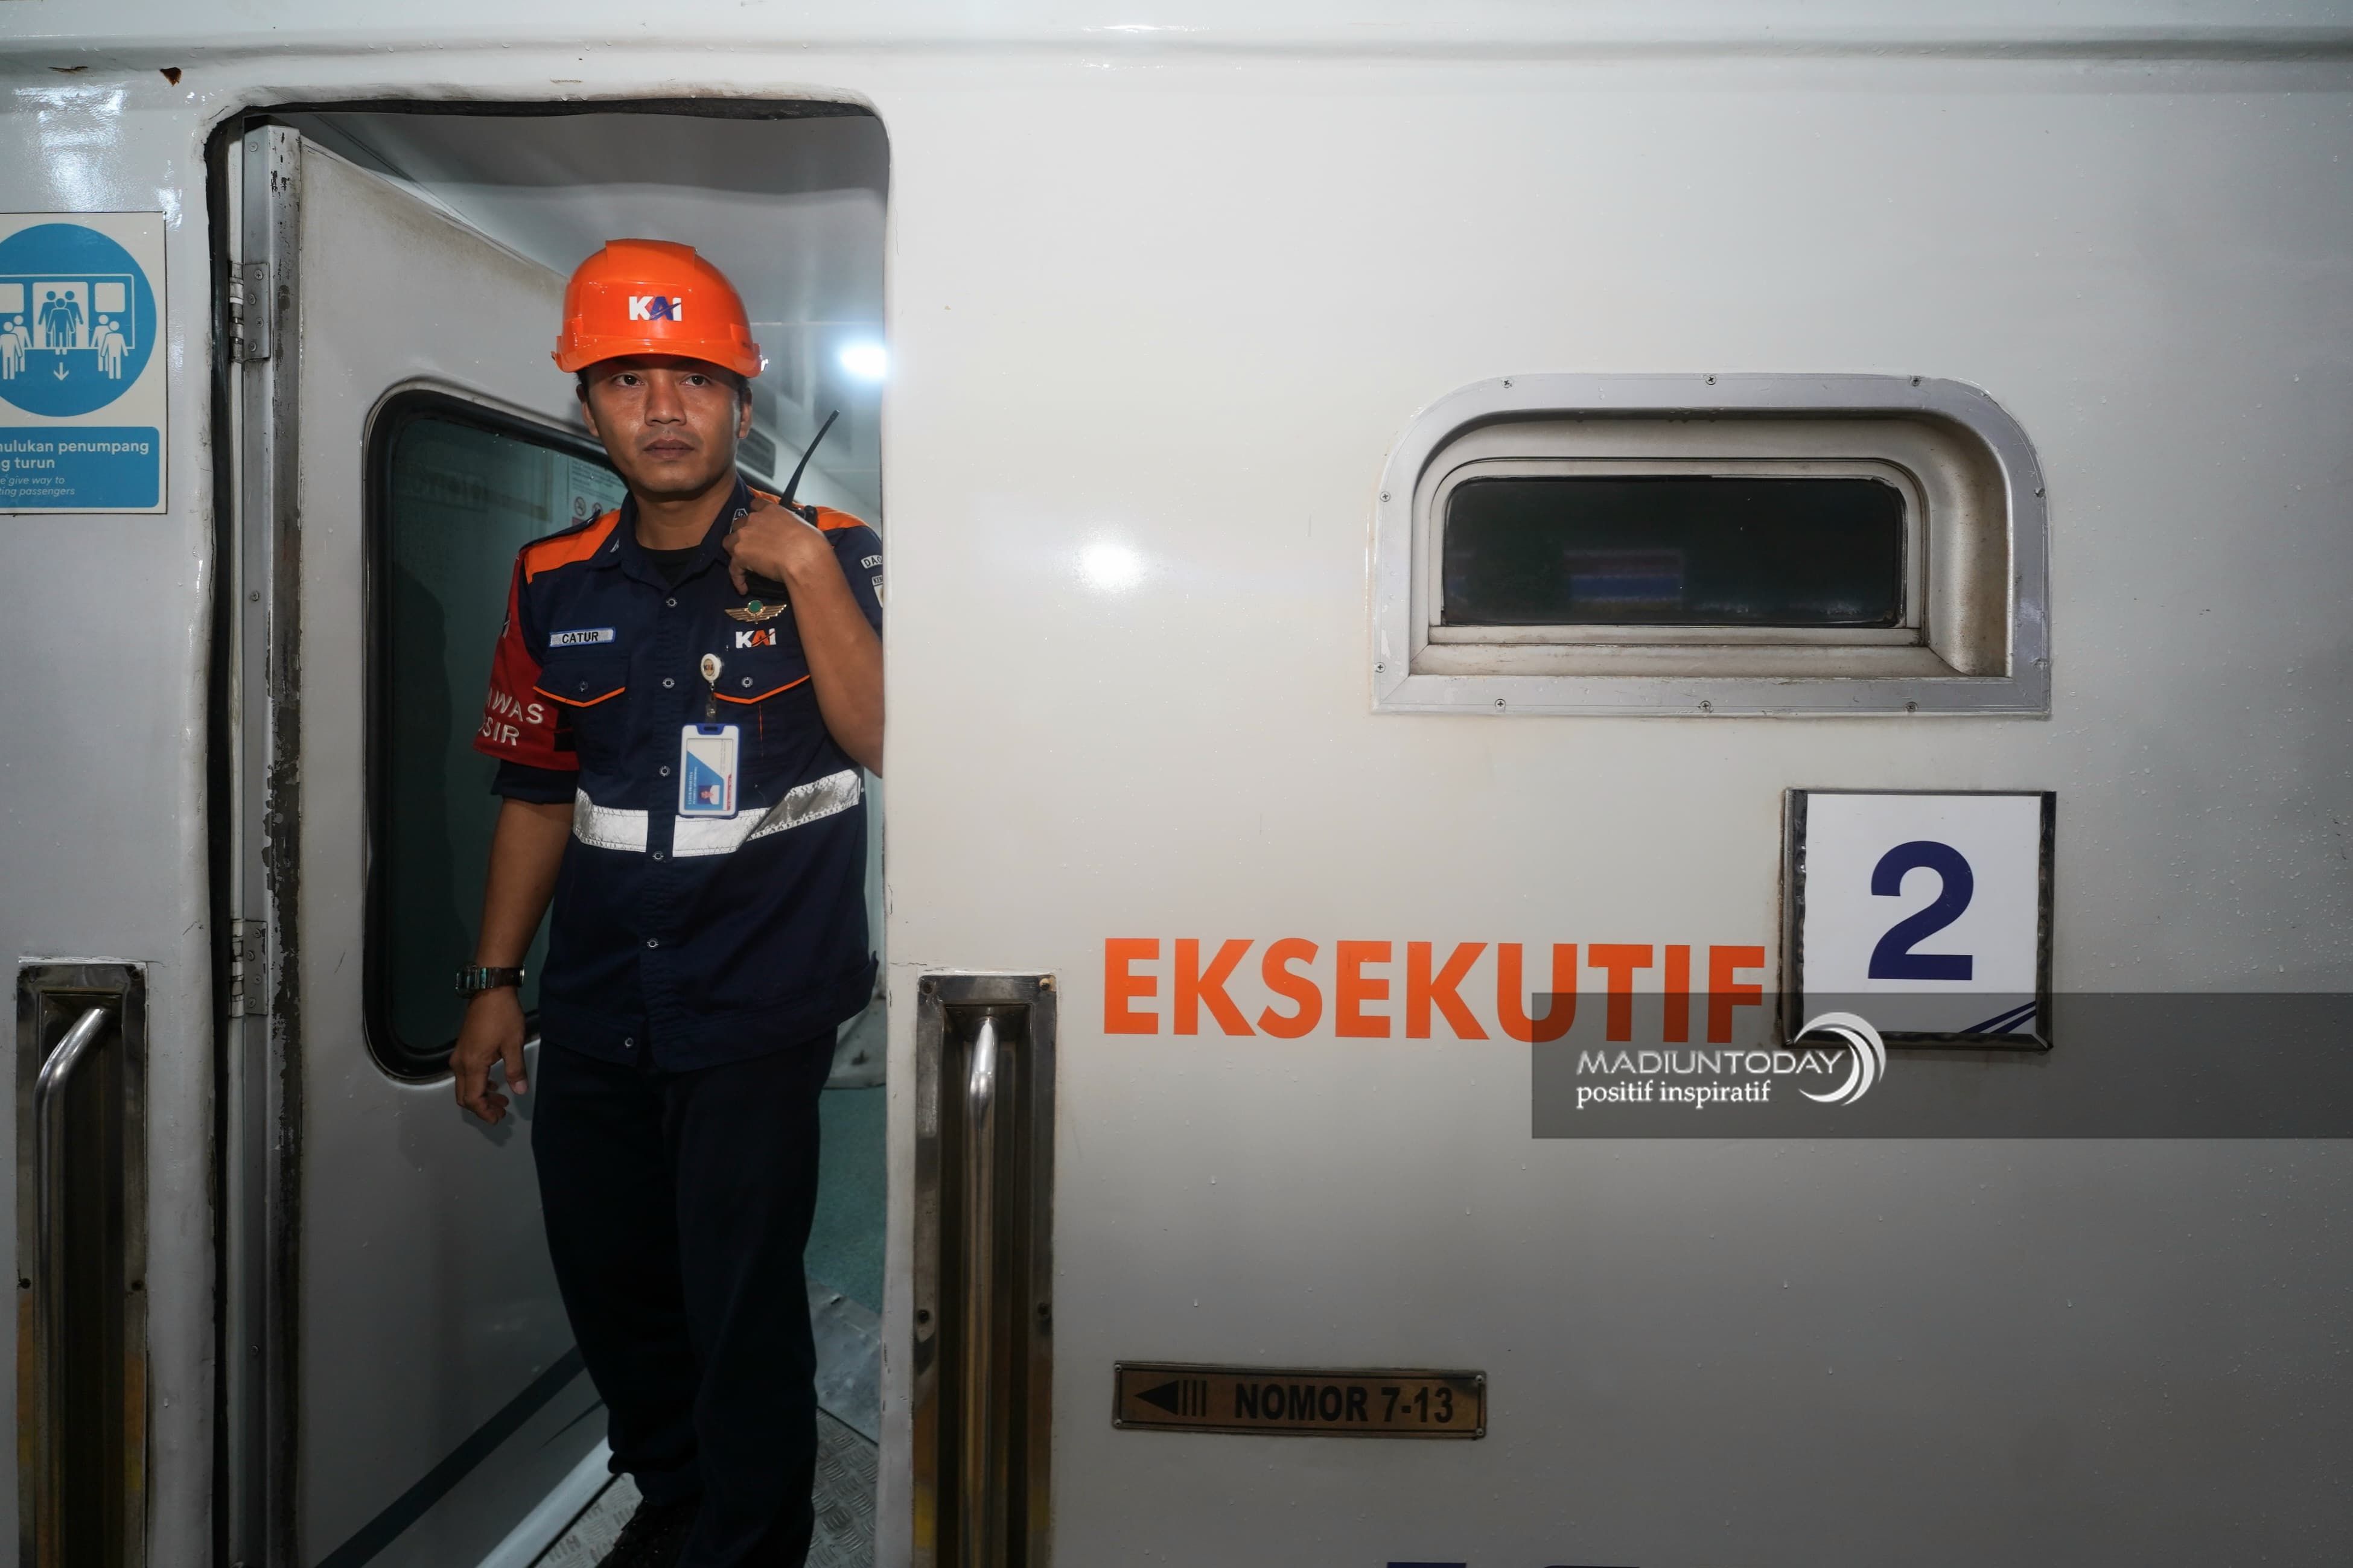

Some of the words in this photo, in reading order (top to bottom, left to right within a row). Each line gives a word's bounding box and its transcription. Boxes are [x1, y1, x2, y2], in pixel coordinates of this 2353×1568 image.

[629, 296, 682, 321] KAI
[59, 442, 149, 455] penumpang
[14, 457, 55, 469] turun
[8, 475, 30, 486] give
[32, 477, 52, 486] way
[19, 488, 75, 497] passengers
[562, 632, 599, 644] CATUR
[736, 628, 777, 649] KAI
[1869, 841, 1974, 980] 2
[1104, 938, 1766, 1044] EKSEKUTIF
[1234, 1383, 1369, 1422] NOMOR
[1381, 1386, 1454, 1423] 7-13
